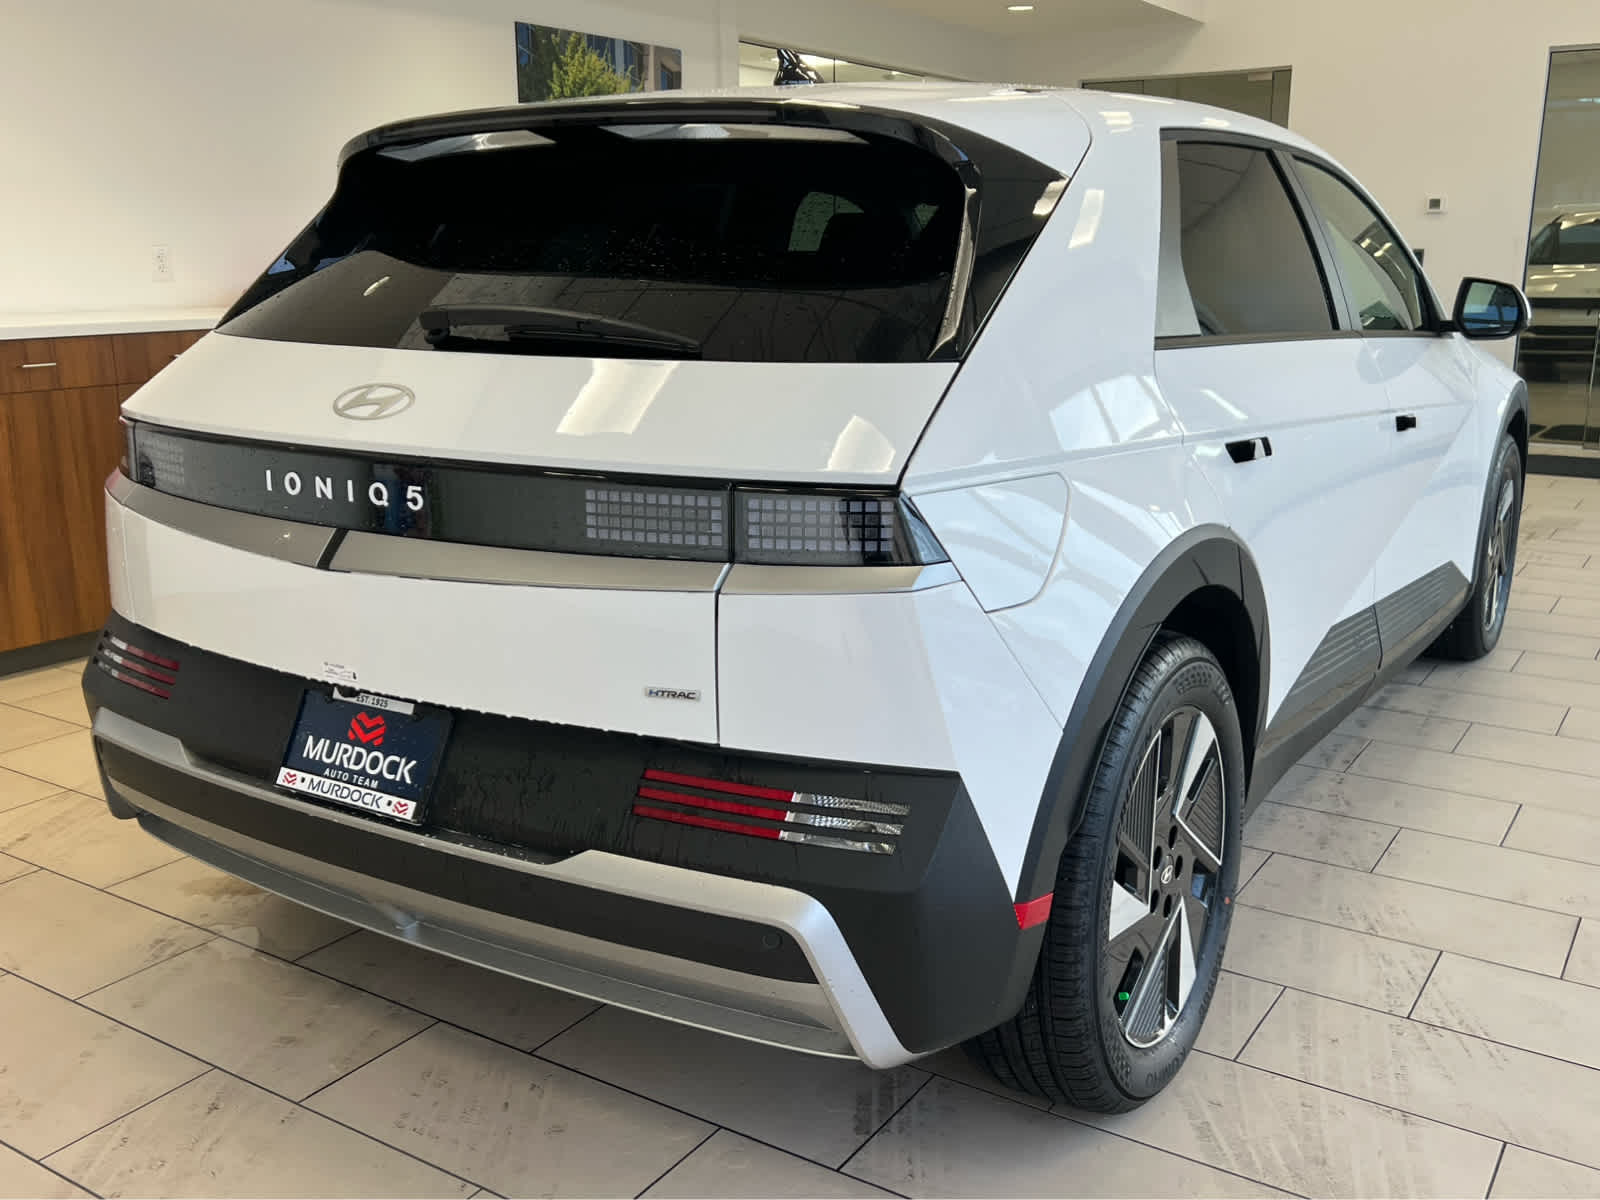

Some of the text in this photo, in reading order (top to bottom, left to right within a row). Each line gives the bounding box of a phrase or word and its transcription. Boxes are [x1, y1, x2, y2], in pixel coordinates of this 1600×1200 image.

[265, 469, 424, 511] IONIQ 5
[371, 696, 388, 708] 1925
[647, 688, 697, 700] HTRAC
[302, 735, 417, 784] MURDOCK
[323, 767, 379, 789] AUTO TEAM
[307, 777, 383, 809] MURDOCK
